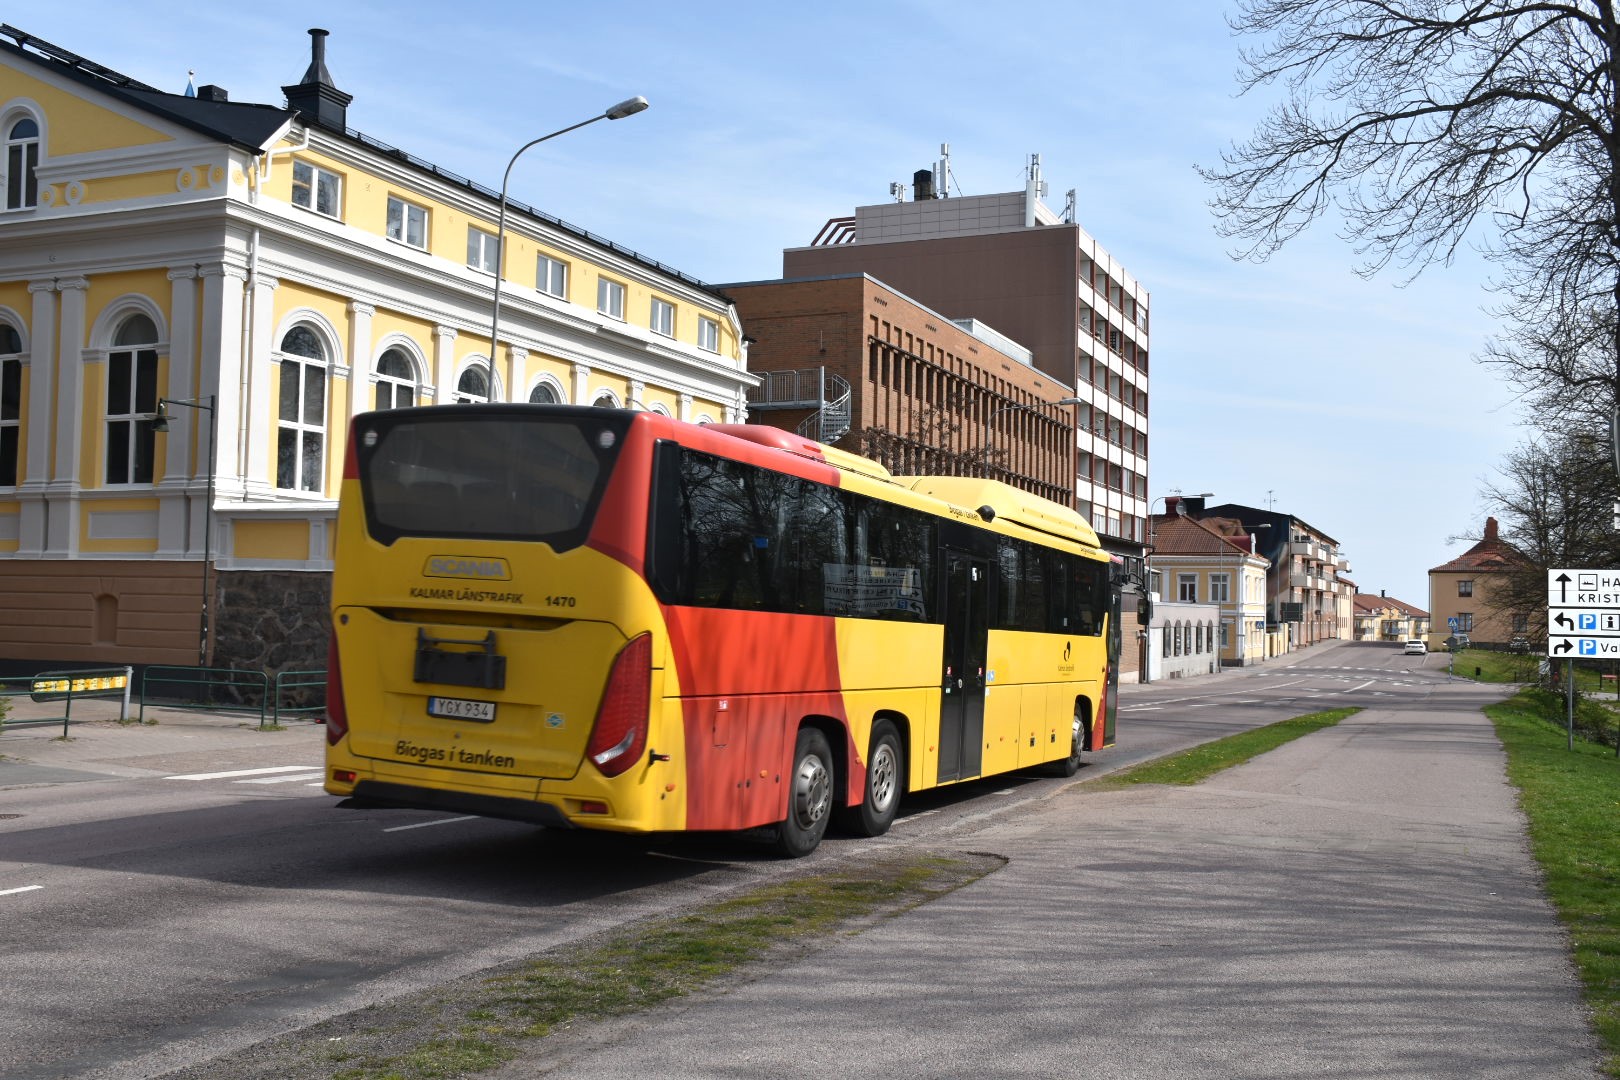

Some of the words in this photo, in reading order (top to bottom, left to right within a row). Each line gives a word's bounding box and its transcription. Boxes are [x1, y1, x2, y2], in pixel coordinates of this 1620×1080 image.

[431, 558, 505, 577] SCANIA
[1601, 577, 1620, 588] HA
[409, 586, 454, 601] KALMAR
[456, 587, 524, 605] LÄNSTRAFIK
[545, 595, 577, 608] 1470
[1578, 593, 1620, 604] KRIST
[1600, 642, 1620, 653] Va
[438, 699, 462, 715] YGX
[464, 702, 489, 718] 934
[396, 740, 445, 763] Biogas
[449, 746, 457, 762] i
[458, 749, 516, 768] tanken
